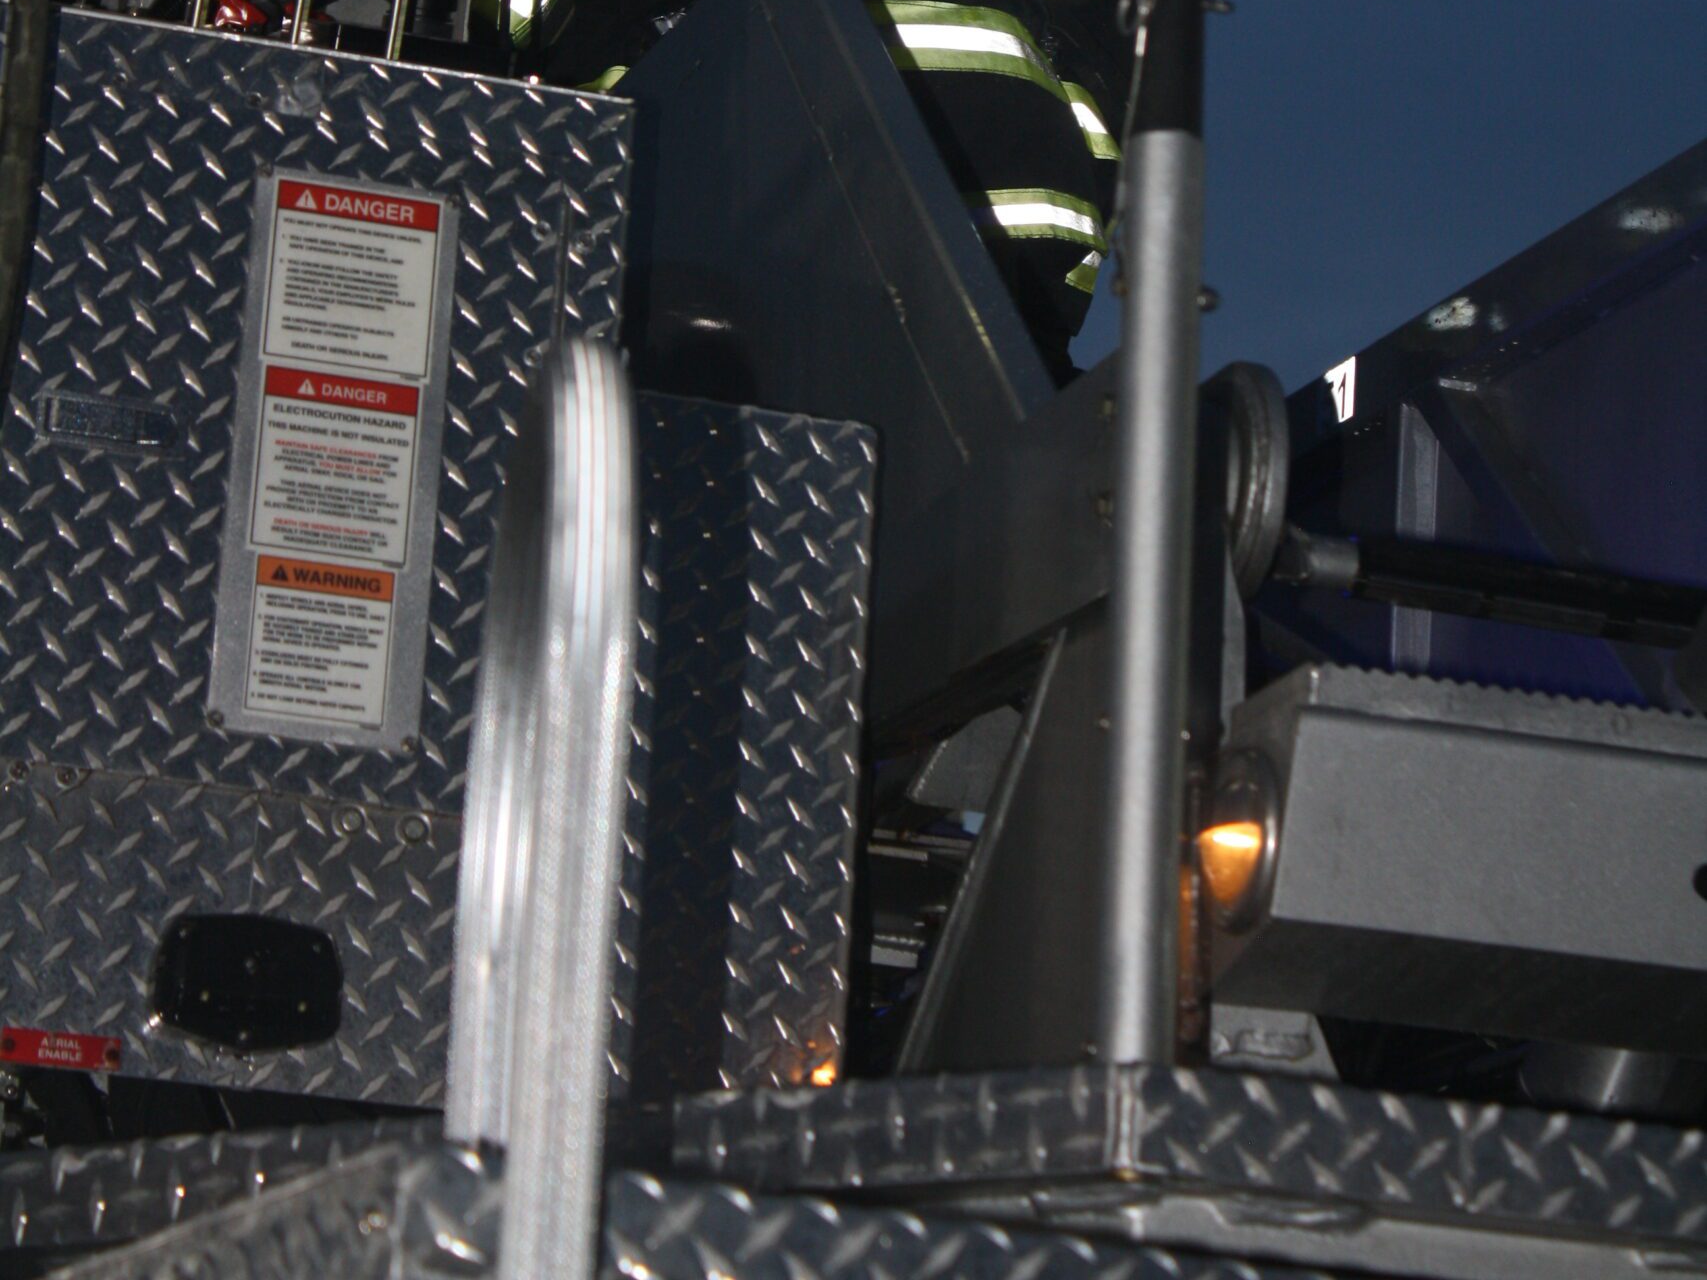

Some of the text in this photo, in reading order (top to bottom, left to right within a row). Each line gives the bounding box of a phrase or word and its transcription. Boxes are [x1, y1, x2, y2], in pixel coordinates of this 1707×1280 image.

[324, 193, 414, 223] DANGER
[321, 383, 386, 404] DANGER
[273, 403, 406, 430] ELECTROCUTION HAZARD
[268, 420, 408, 447] THIS MACHINE IS NOT INSULATED
[292, 567, 381, 592] WARNING
[38, 1047, 82, 1062] ENABLE
